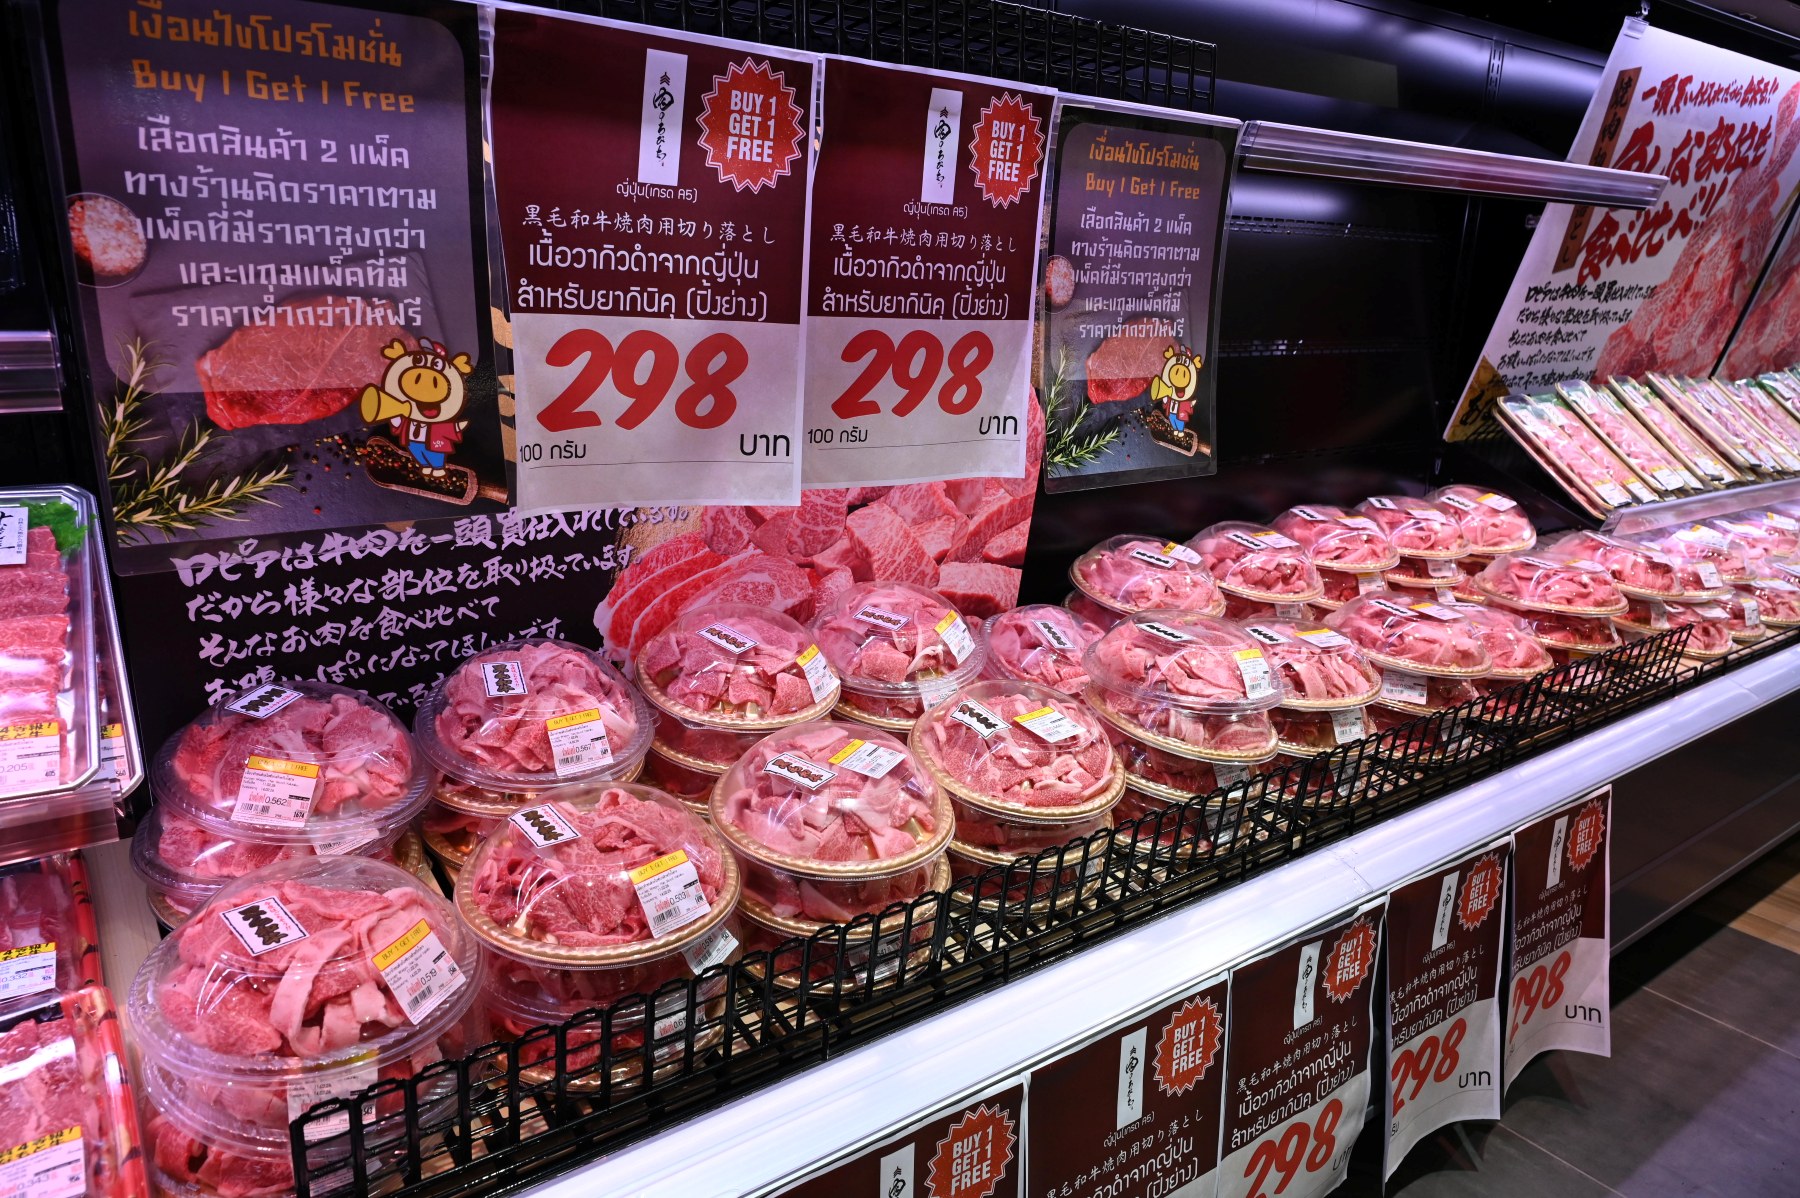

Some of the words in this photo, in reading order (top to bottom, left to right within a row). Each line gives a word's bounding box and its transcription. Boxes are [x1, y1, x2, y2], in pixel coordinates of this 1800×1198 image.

[132, 59, 205, 102] Buy
[247, 71, 307, 102] Get
[346, 82, 414, 113] Free
[730, 89, 764, 114] BUY
[769, 97, 777, 117] 1
[138, 115, 307, 162] เลือกสินค้า
[321, 139, 338, 163] 2
[350, 135, 410, 168] แพ็ค
[729, 116, 762, 137] GET
[767, 120, 775, 140] 1
[991, 119, 1015, 140] BUY
[1019, 124, 1026, 142] 1
[726, 136, 774, 163] FREE
[989, 140, 1013, 160] GET
[1016, 143, 1024, 162] 1
[988, 161, 1021, 183] FREE
[124, 165, 436, 210] ทางร้านคิดราคาตาม
[678, 188, 698, 203] A5)
[1086, 173, 1115, 198] Buy
[1131, 178, 1155, 196] Get
[1170, 180, 1200, 200] Free
[134, 201, 426, 256] แพ็คที่มีราคาสูงกว่า
[522, 204, 776, 245] 黒毛和牛焼肉用切り落とし
[1080, 205, 1149, 232] เลือกสินค้า
[1154, 218, 1162, 233] 2
[830, 223, 1017, 253] 黒毛和牛焼肉用切り落とし
[179, 244, 408, 288] และแถมแพ็คที่มี
[529, 228, 759, 285] เนื้อวากิวดำจากญี่ปุ่น
[833, 243, 1006, 288] เนื้อวากิวดำจากญี่ปุ่น
[172, 284, 422, 327] ราคาต่ำกว่าให้ฟรี
[536, 328, 749, 433] 298
[831, 329, 994, 420] 298
[807, 428, 834, 445] 100
[839, 425, 868, 443] กรัม
[979, 415, 1018, 435] บาท
[520, 443, 542, 463] 100
[550, 439, 587, 459] กรัม
[739, 433, 791, 457] บาท
[575, 743, 592, 754] 0.567
[264, 795, 288, 807] 0.562
[1469, 882, 1485, 900] GET
[1471, 868, 1487, 887] BUY
[669, 891, 687, 906] 0.503
[1467, 893, 1488, 916] FREE
[420, 968, 438, 986] 0.519
[1336, 960, 1361, 987] FREE
[1509, 950, 1571, 1045] 298
[1565, 1004, 1602, 1024] บาท
[1173, 1020, 1196, 1042] BUY
[1199, 1016, 1206, 1030] 1
[1172, 1038, 1194, 1060] GET
[1197, 1034, 1204, 1047] 1
[1236, 1015, 1359, 1095] 黒毛和牛焼肉用切り落とし
[1171, 1047, 1203, 1079] FREE
[1391, 1017, 1466, 1119] 298
[1458, 1070, 1492, 1089] บาท
[953, 1130, 983, 1160] BUY
[986, 1125, 994, 1143] 1
[1243, 1098, 1344, 1198] 298
[951, 1148, 980, 1177] GET
[985, 1142, 992, 1160] 1
[950, 1159, 991, 1197] FREE
